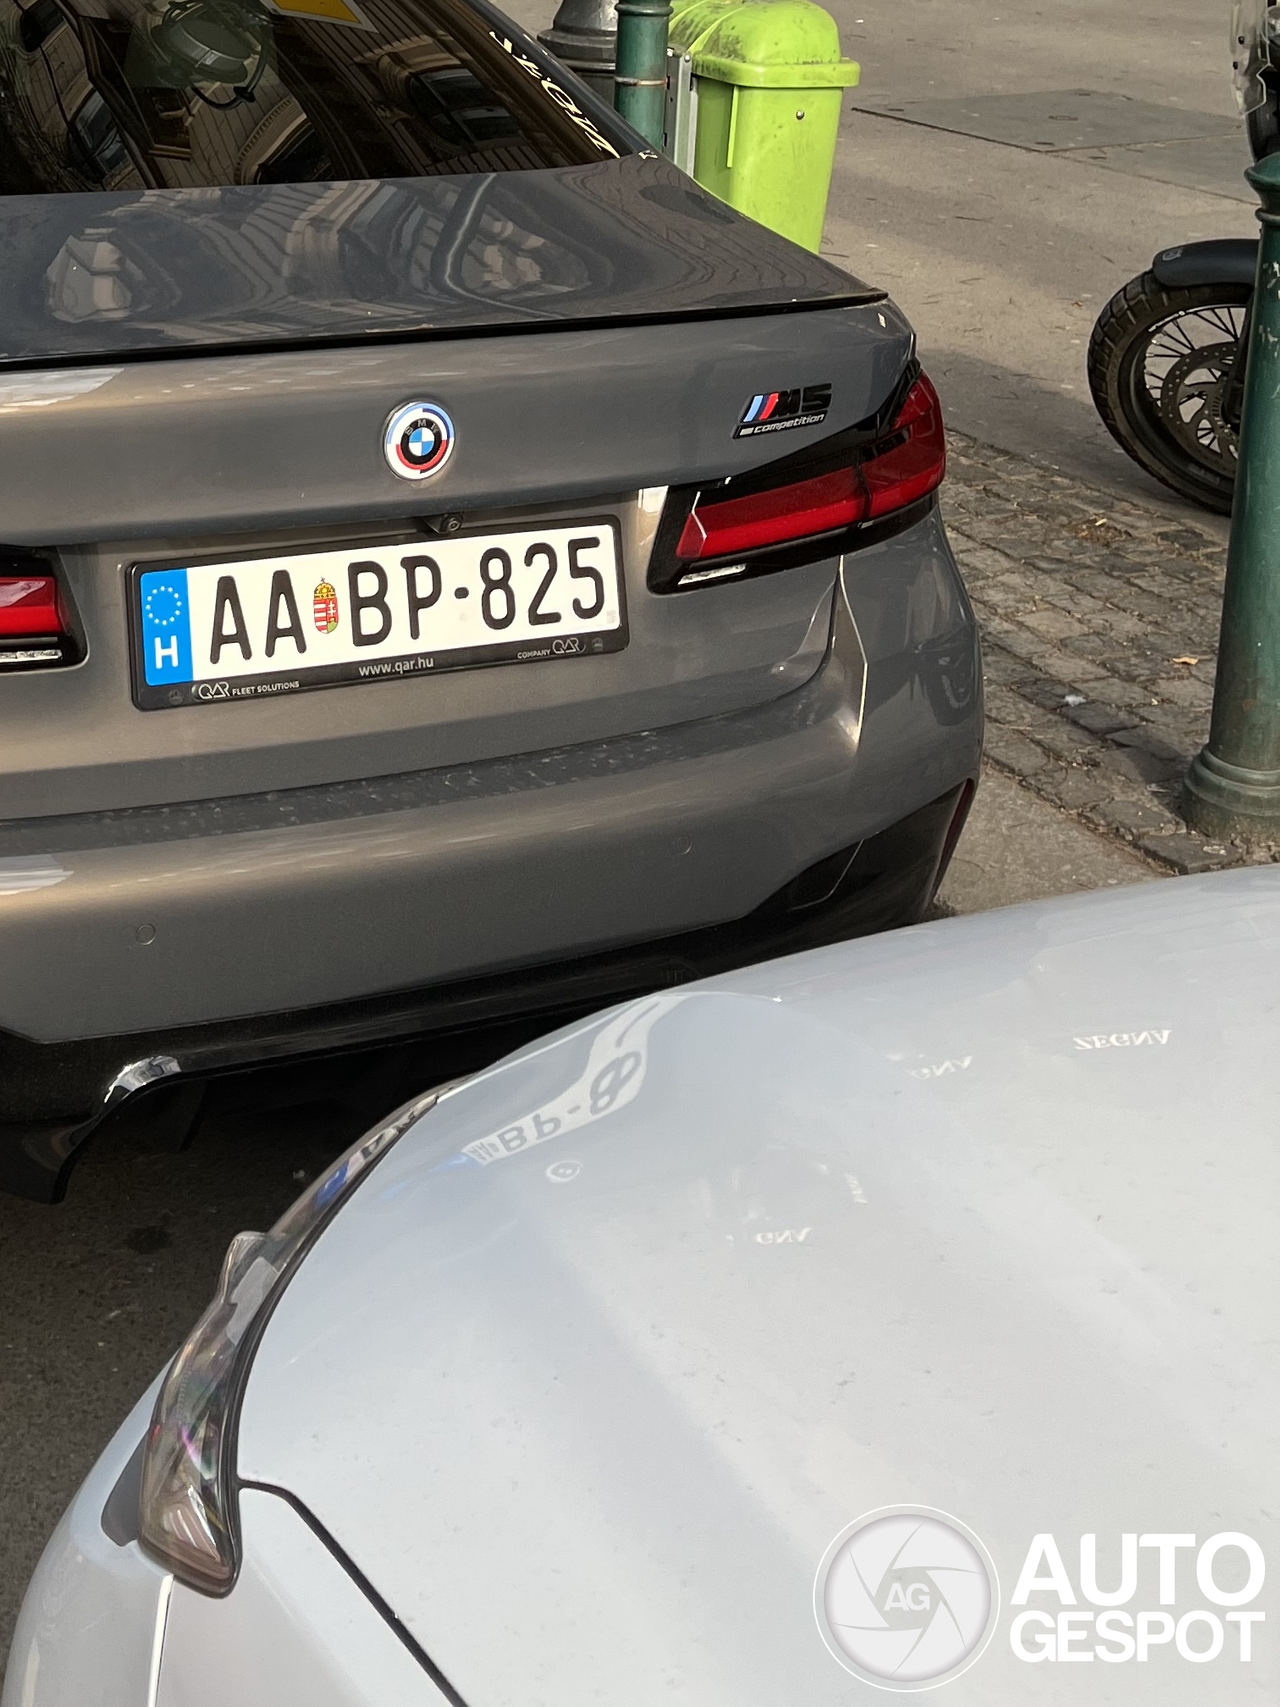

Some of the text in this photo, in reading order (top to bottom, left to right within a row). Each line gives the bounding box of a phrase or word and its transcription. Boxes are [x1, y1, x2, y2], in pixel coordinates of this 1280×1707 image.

[753, 412, 825, 434] competition
[210, 536, 605, 664] AA BP-825
[154, 634, 179, 669] H
[517, 648, 551, 659] COMPANY
[358, 657, 434, 676] www.qar.hu
[232, 686, 256, 696] FLEET
[257, 680, 300, 694] SOLUTIONS
